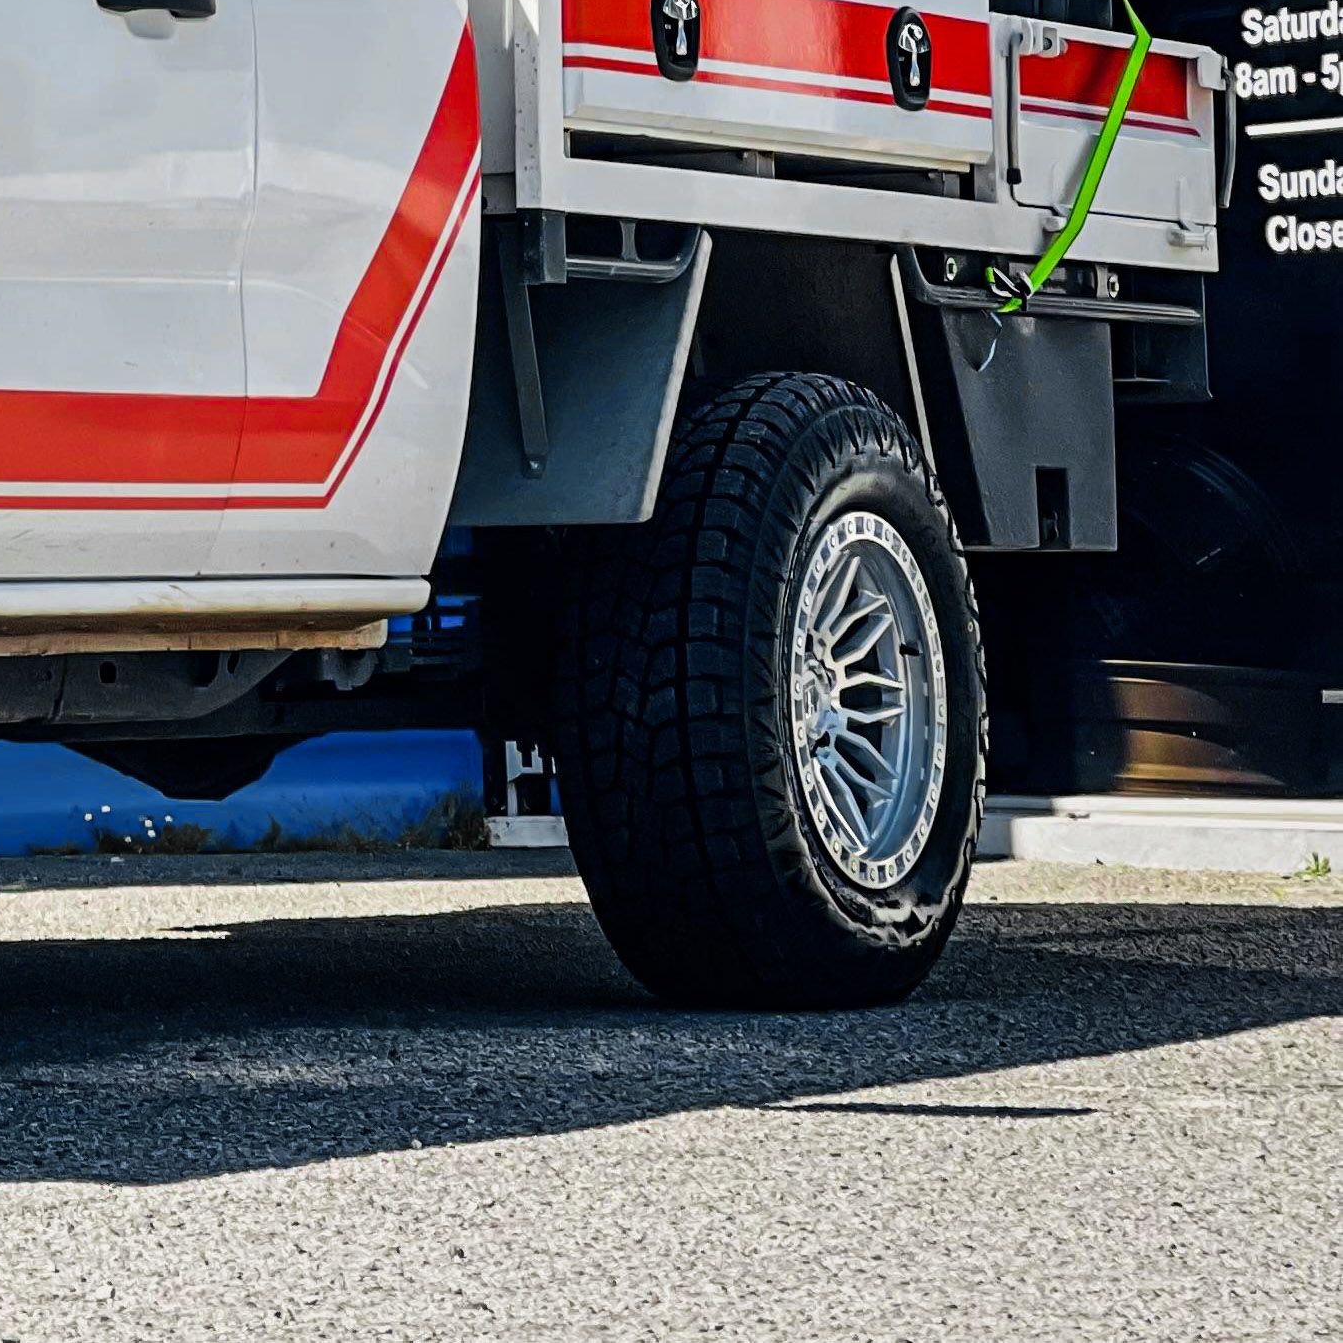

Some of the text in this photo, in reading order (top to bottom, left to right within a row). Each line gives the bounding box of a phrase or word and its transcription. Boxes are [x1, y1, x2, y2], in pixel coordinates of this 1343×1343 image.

[1240, 0, 1343, 46] Saturd
[1234, 61, 1297, 99] 8am
[1257, 159, 1343, 201] Sund
[1266, 215, 1343, 252] Close
